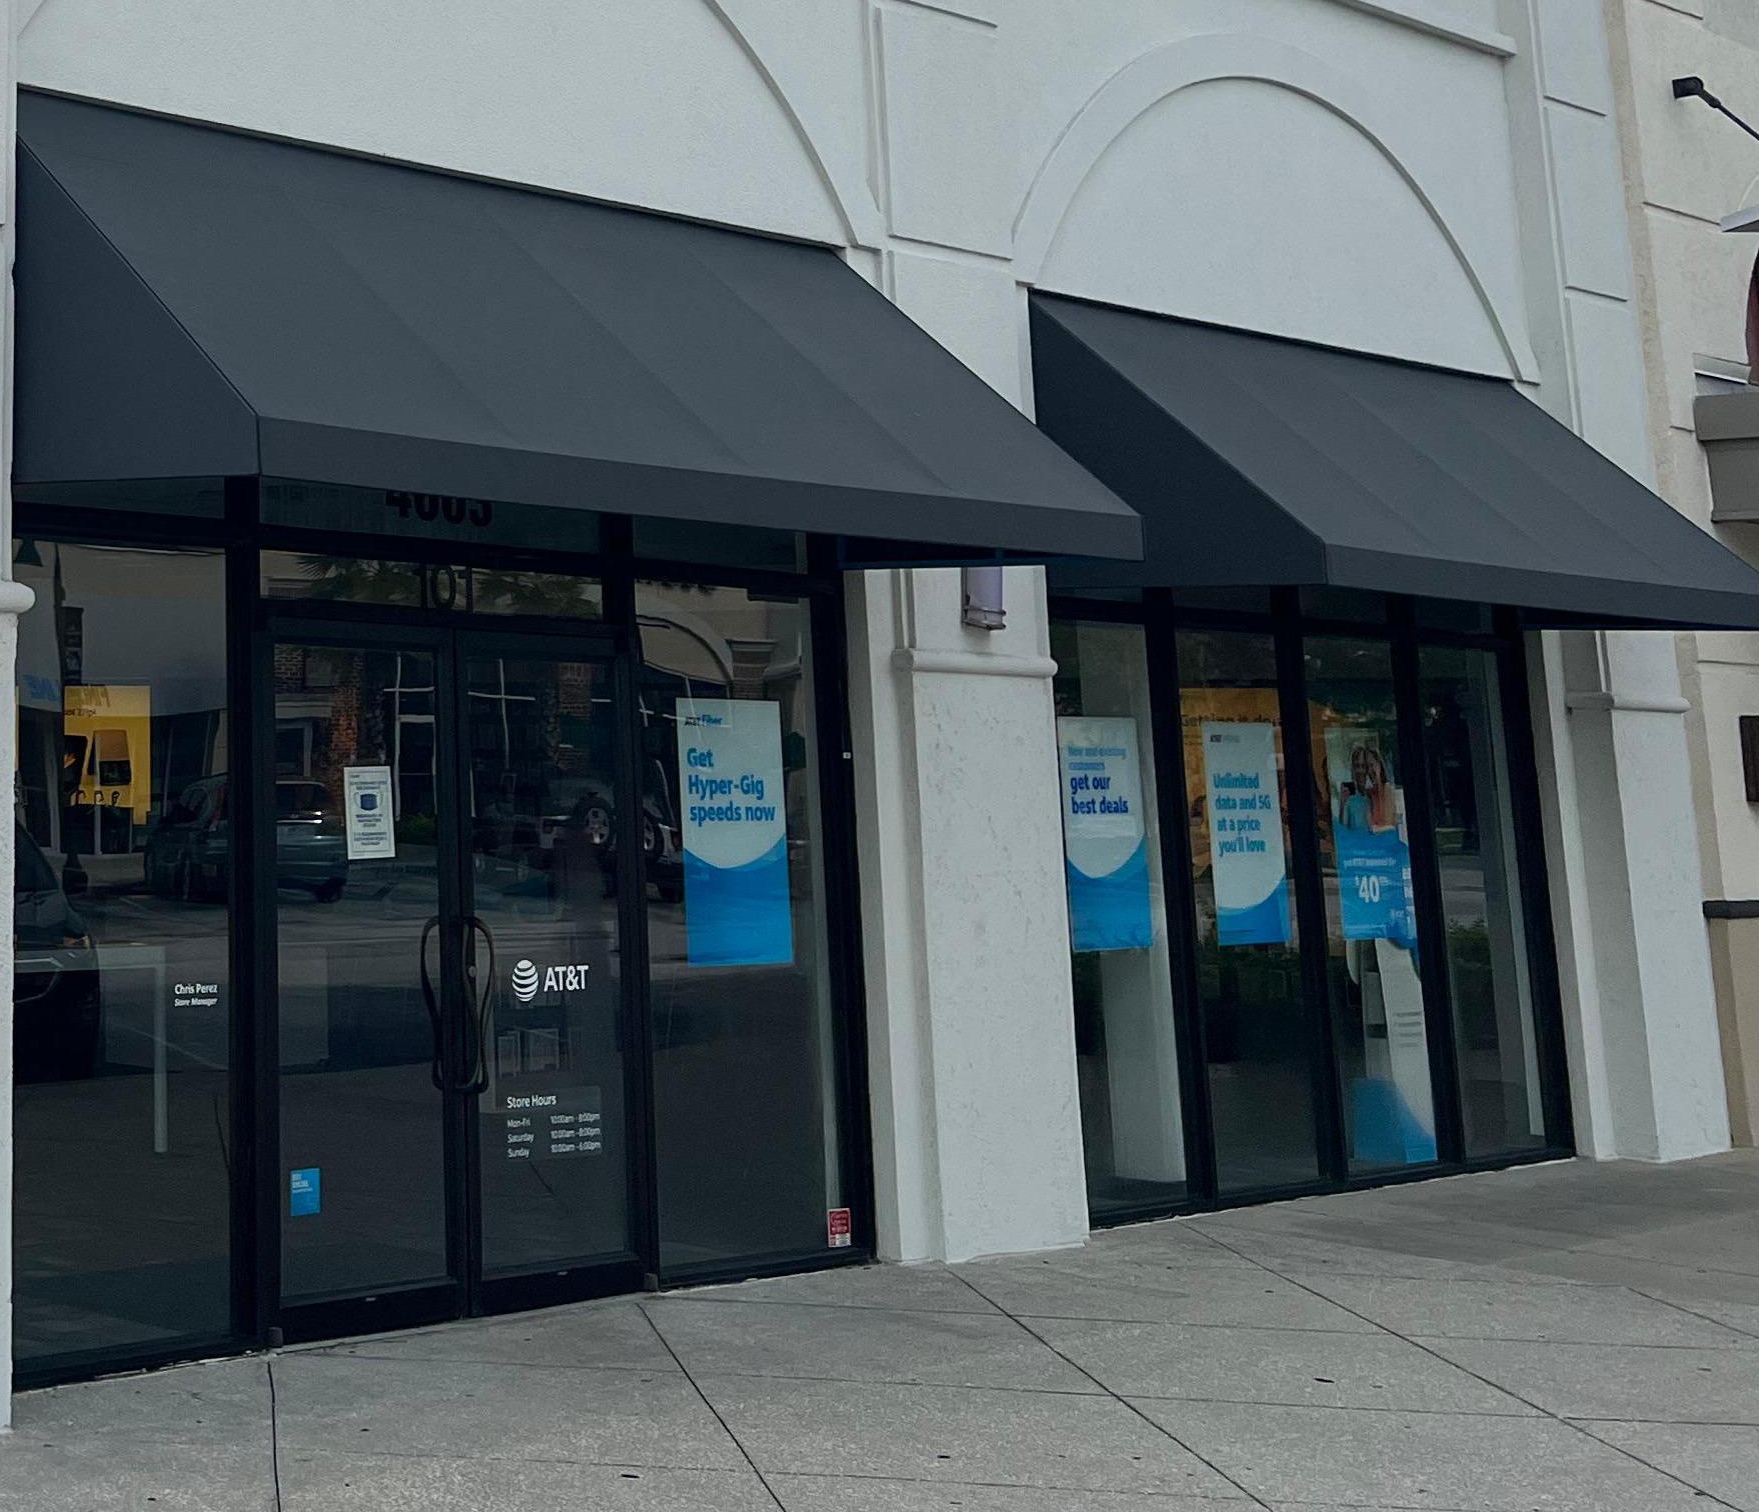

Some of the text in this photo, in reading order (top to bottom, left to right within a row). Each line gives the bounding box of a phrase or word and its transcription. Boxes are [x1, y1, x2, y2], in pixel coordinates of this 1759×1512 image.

[413, 565, 473, 613] 101
[687, 748, 714, 768] Get
[688, 774, 765, 801] Hyper-Gig
[1070, 773, 1111, 795] get our
[1213, 772, 1260, 789] Unlimited
[1071, 795, 1129, 815] best deals
[1215, 794, 1271, 810] data and 5G
[690, 801, 776, 827] speeds now
[1217, 815, 1261, 835] at a price
[1218, 837, 1266, 857] you'll love
[543, 965, 589, 992] AT&T
[174, 983, 218, 995] Chris Perez
[174, 998, 218, 1007] Store Manager
[507, 1095, 557, 1108] Store Hours
[507, 1117, 531, 1128] Mon-Fri
[507, 1133, 534, 1144] Saturday
[507, 1148, 530, 1159] Sunday
